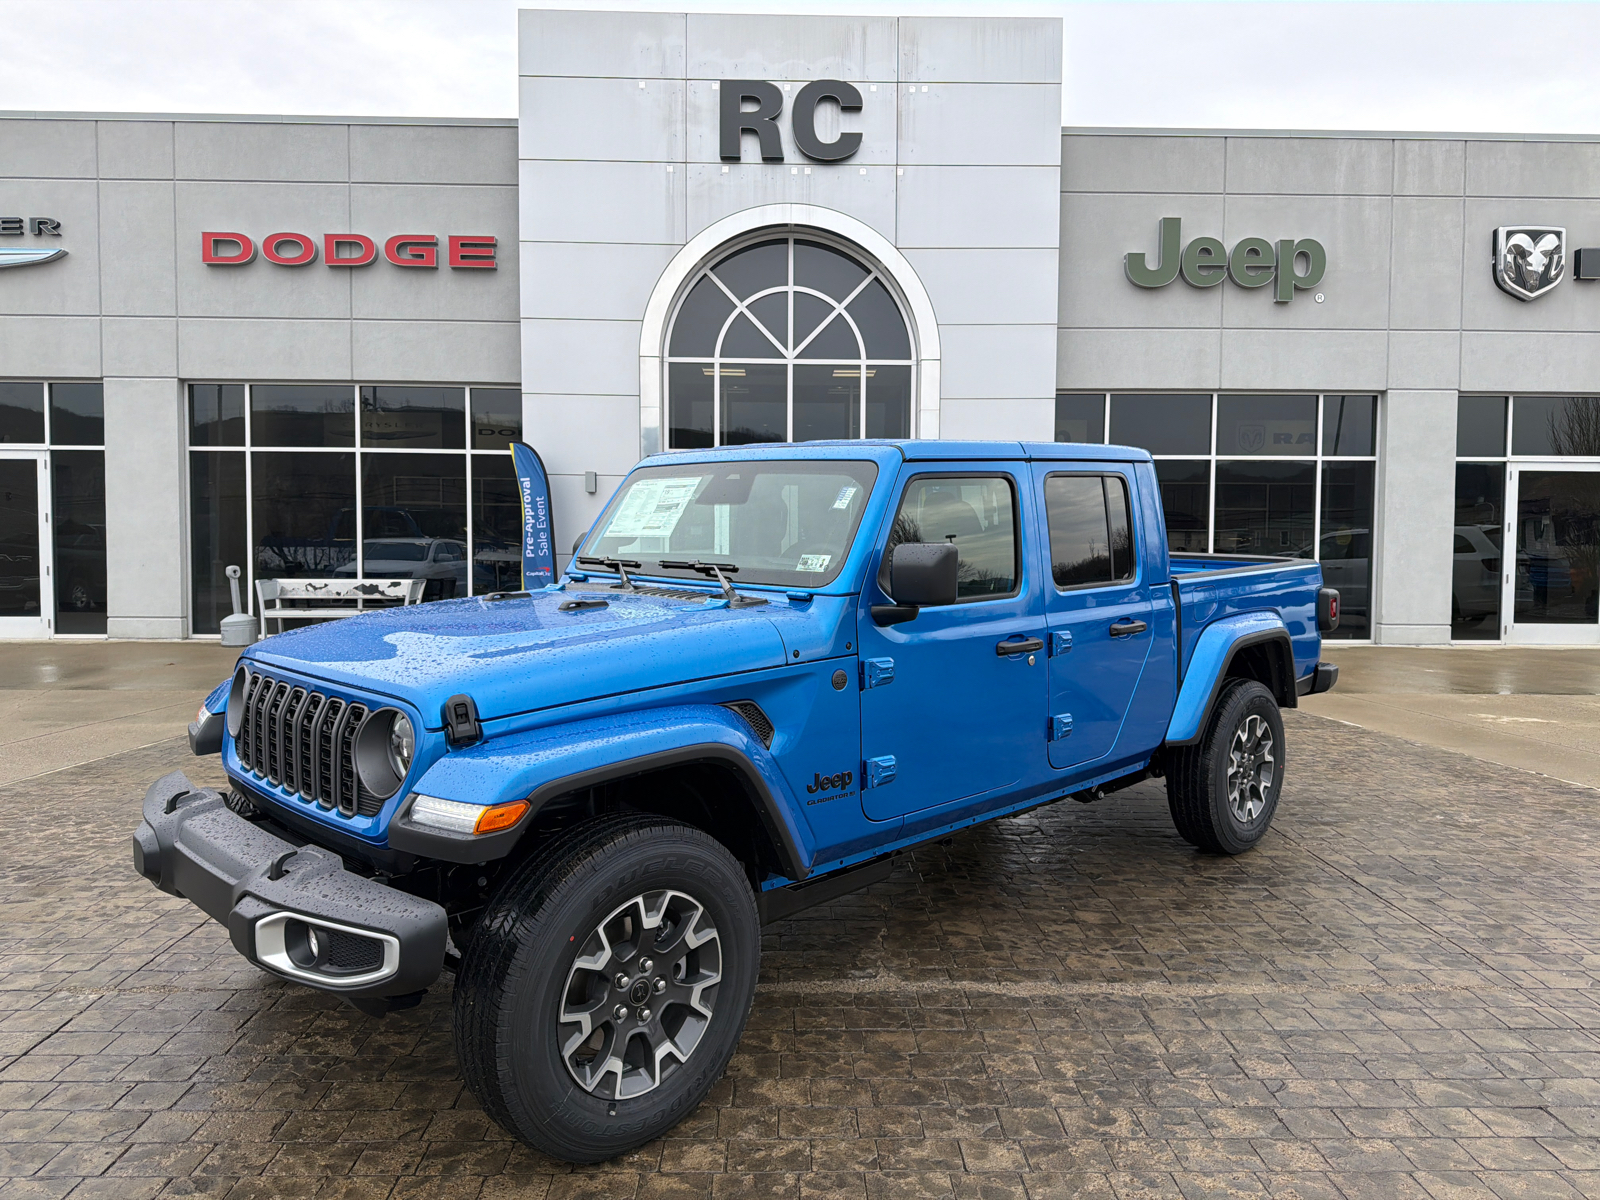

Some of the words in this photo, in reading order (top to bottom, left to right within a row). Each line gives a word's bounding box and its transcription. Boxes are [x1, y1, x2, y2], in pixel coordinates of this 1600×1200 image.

[719, 79, 864, 164] RC
[201, 231, 498, 271] DODGE
[1124, 216, 1327, 304] Jeep
[478, 428, 521, 437] DO
[520, 477, 535, 558] Pre-Approval
[536, 496, 547, 529] Event
[537, 530, 549, 556] Sale
[806, 770, 853, 794] Jeep
[806, 792, 849, 806] GLADIATOR
